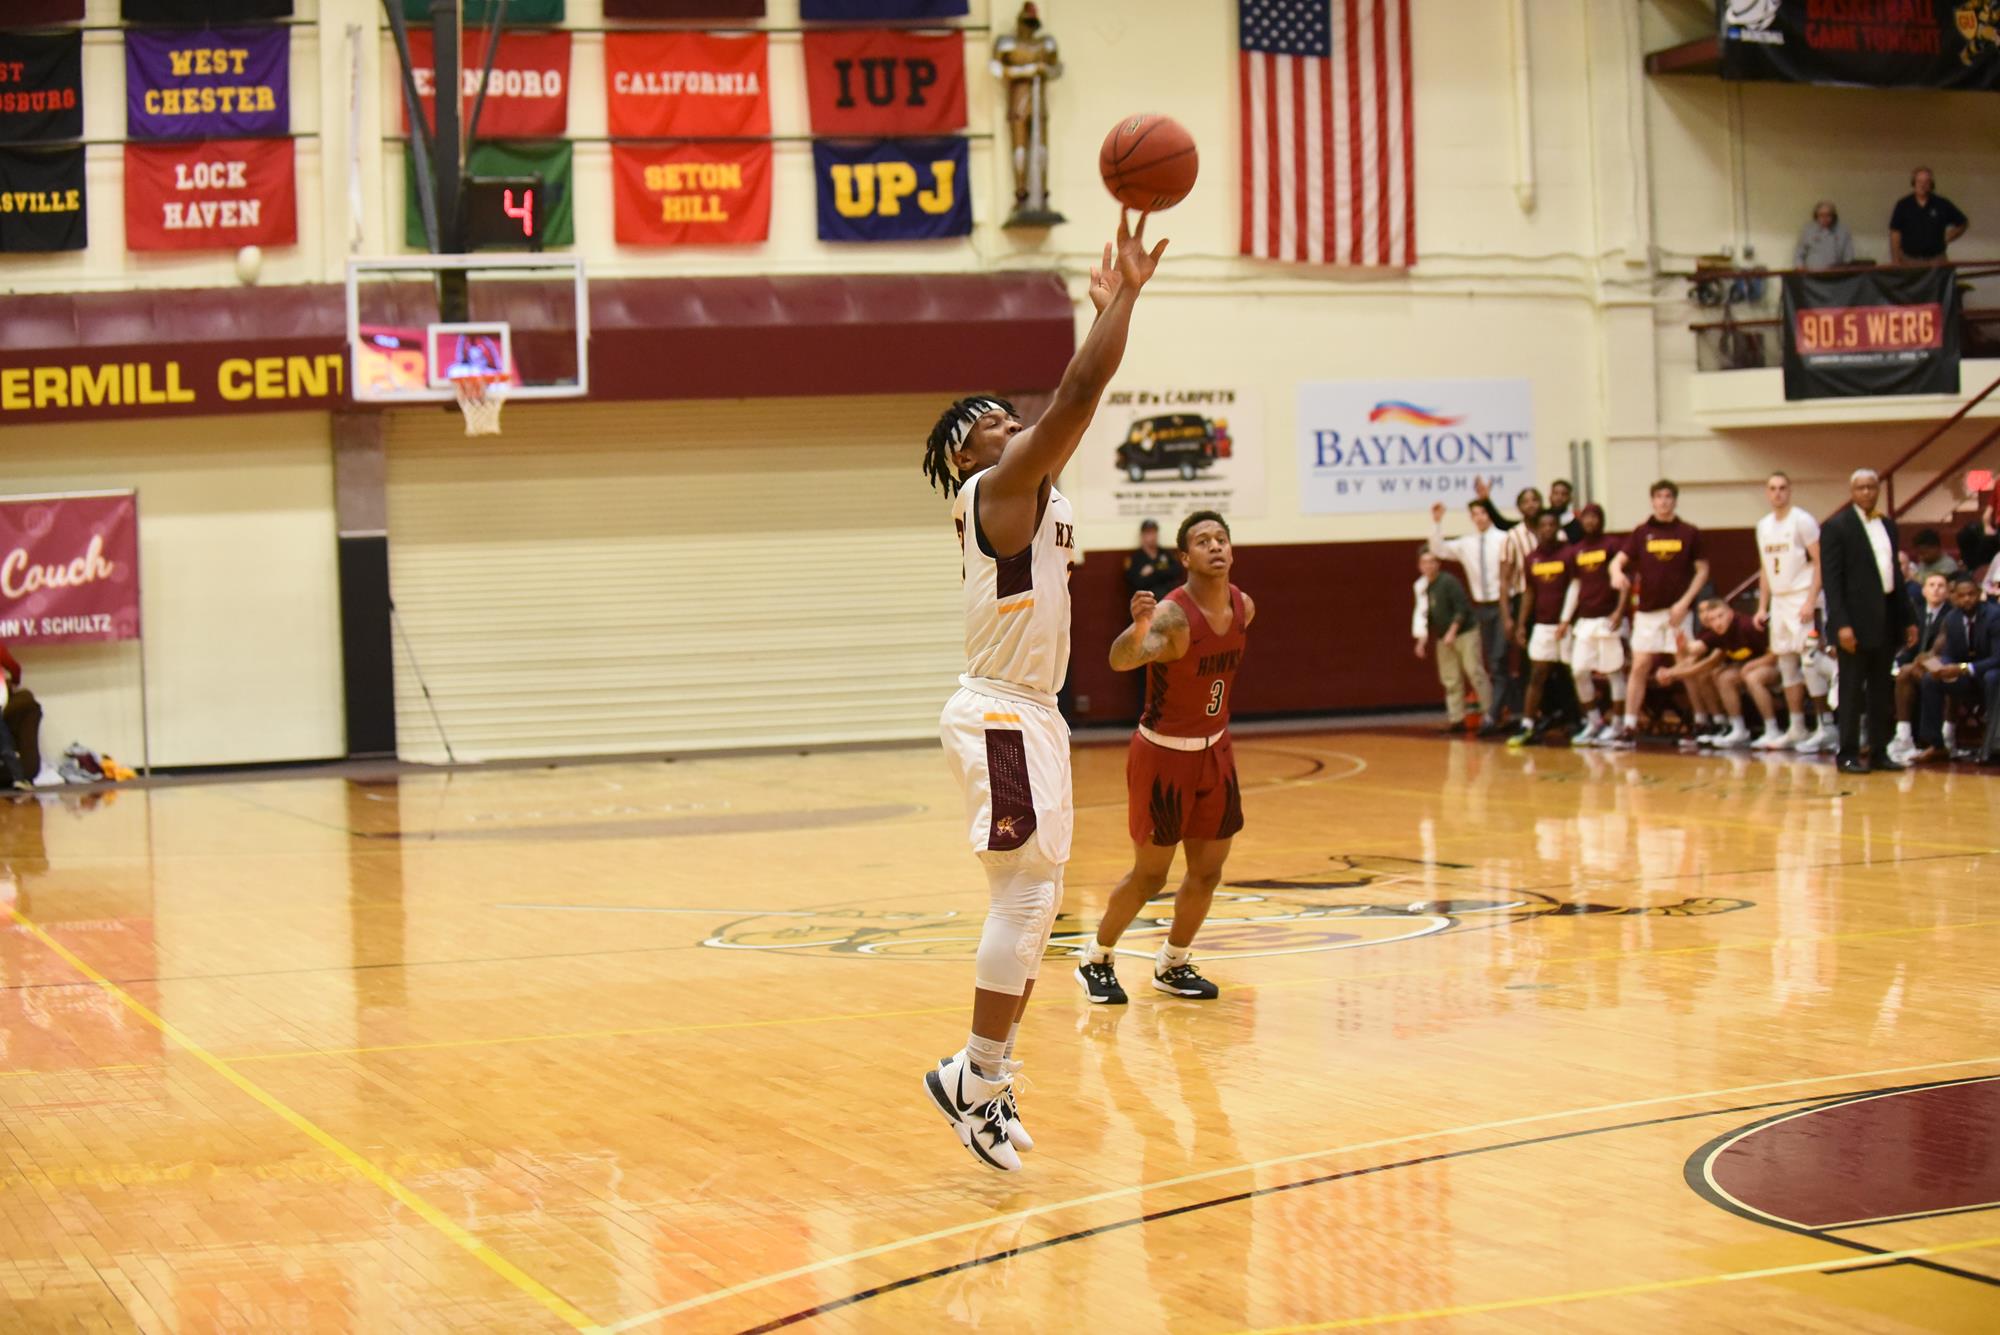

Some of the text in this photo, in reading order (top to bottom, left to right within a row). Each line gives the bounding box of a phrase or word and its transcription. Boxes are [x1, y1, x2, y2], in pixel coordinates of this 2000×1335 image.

[169, 48, 248, 76] WEST
[411, 67, 561, 97] ENBORO
[614, 71, 760, 95] CALIFORNIA
[834, 58, 937, 108] IUP
[0, 88, 76, 113] SBURG
[145, 86, 276, 115] CHESTER
[175, 161, 248, 190] LOCK
[644, 162, 742, 190] SETON
[830, 160, 955, 217] UPJ
[0, 189, 79, 213] SVILLE
[163, 200, 261, 229] HAVEN
[503, 188, 534, 237] 4
[662, 195, 728, 222] HILL
[1803, 310, 1934, 348] 90.5 WERG
[1312, 429, 1522, 468] BAYMONT
[1336, 479, 1364, 495] BY
[1, 533, 114, 598] Couch
[23, 617, 38, 636] V.
[42, 613, 112, 636] SCHULTZ
[1206, 679, 1225, 716] 3
